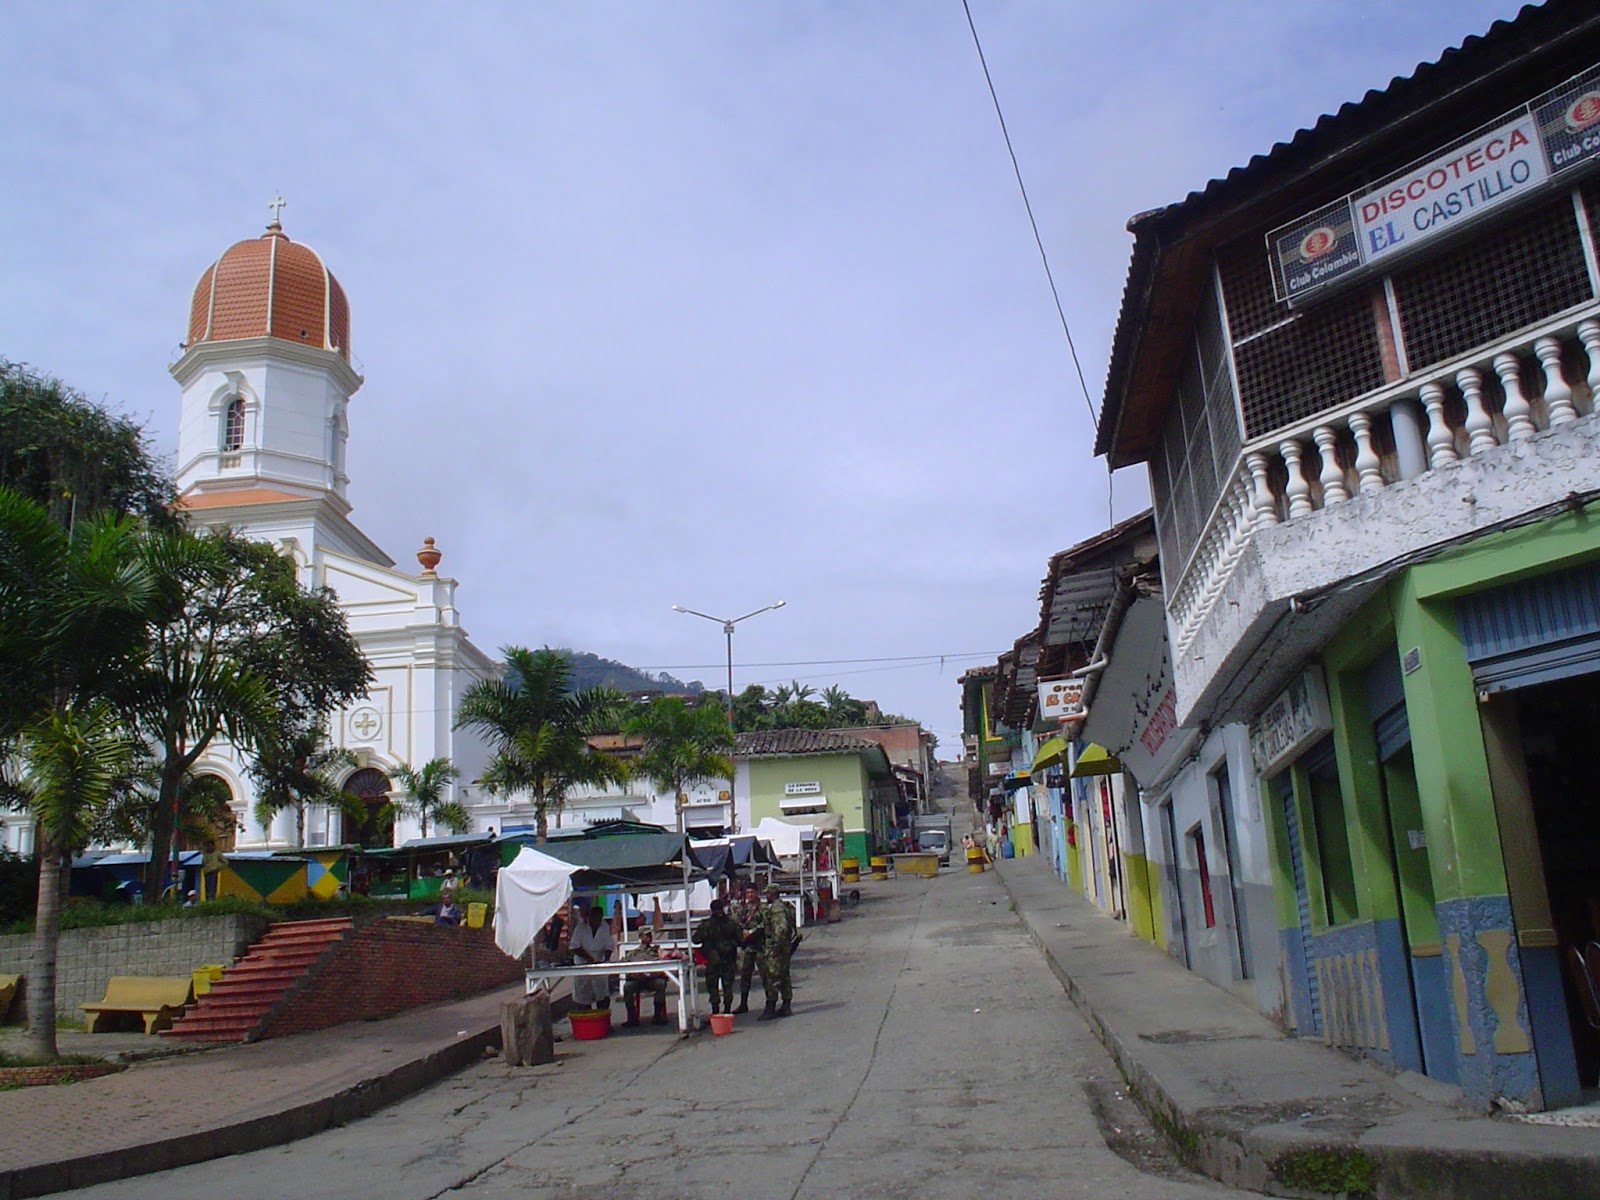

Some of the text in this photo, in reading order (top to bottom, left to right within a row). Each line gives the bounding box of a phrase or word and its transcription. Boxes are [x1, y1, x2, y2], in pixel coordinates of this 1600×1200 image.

[1361, 128, 1529, 223] DISCOTECA
[1553, 144, 1581, 165] Club
[1368, 159, 1530, 254] EL CASTILLO
[1289, 251, 1358, 290] Club Colombia
